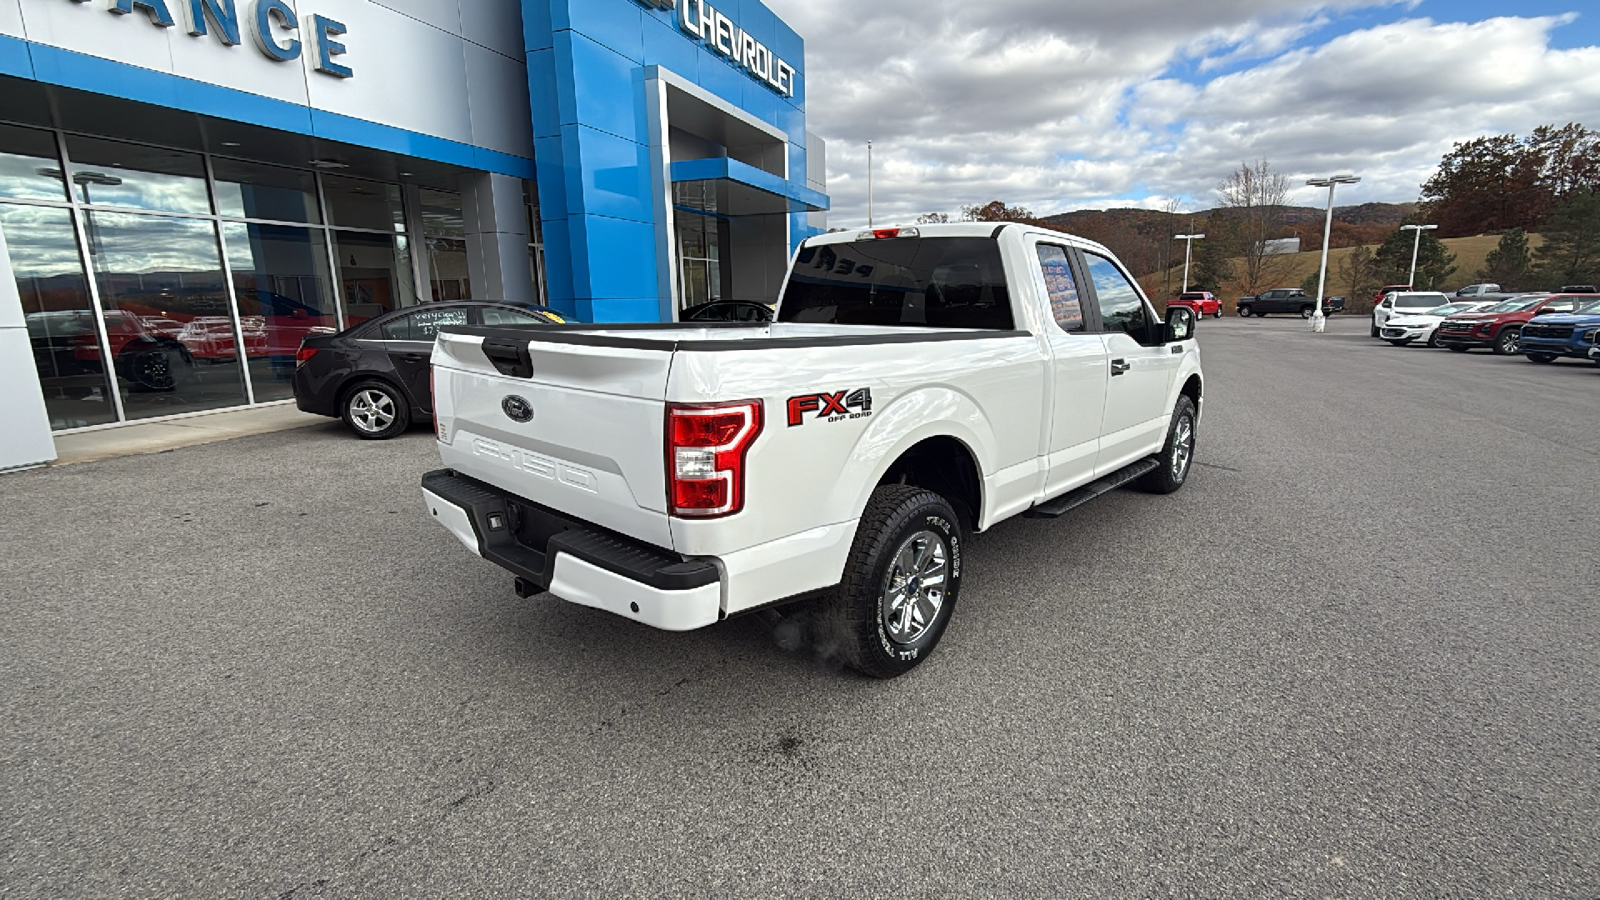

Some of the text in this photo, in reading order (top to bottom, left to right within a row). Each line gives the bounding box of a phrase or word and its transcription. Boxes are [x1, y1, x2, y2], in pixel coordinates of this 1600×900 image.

[680, 0, 796, 98] CHEVROLET
[786, 387, 873, 428] FX4
[827, 411, 873, 423] OFF ROAD
[472, 438, 598, 495] F-150
[899, 648, 918, 661] ALL
